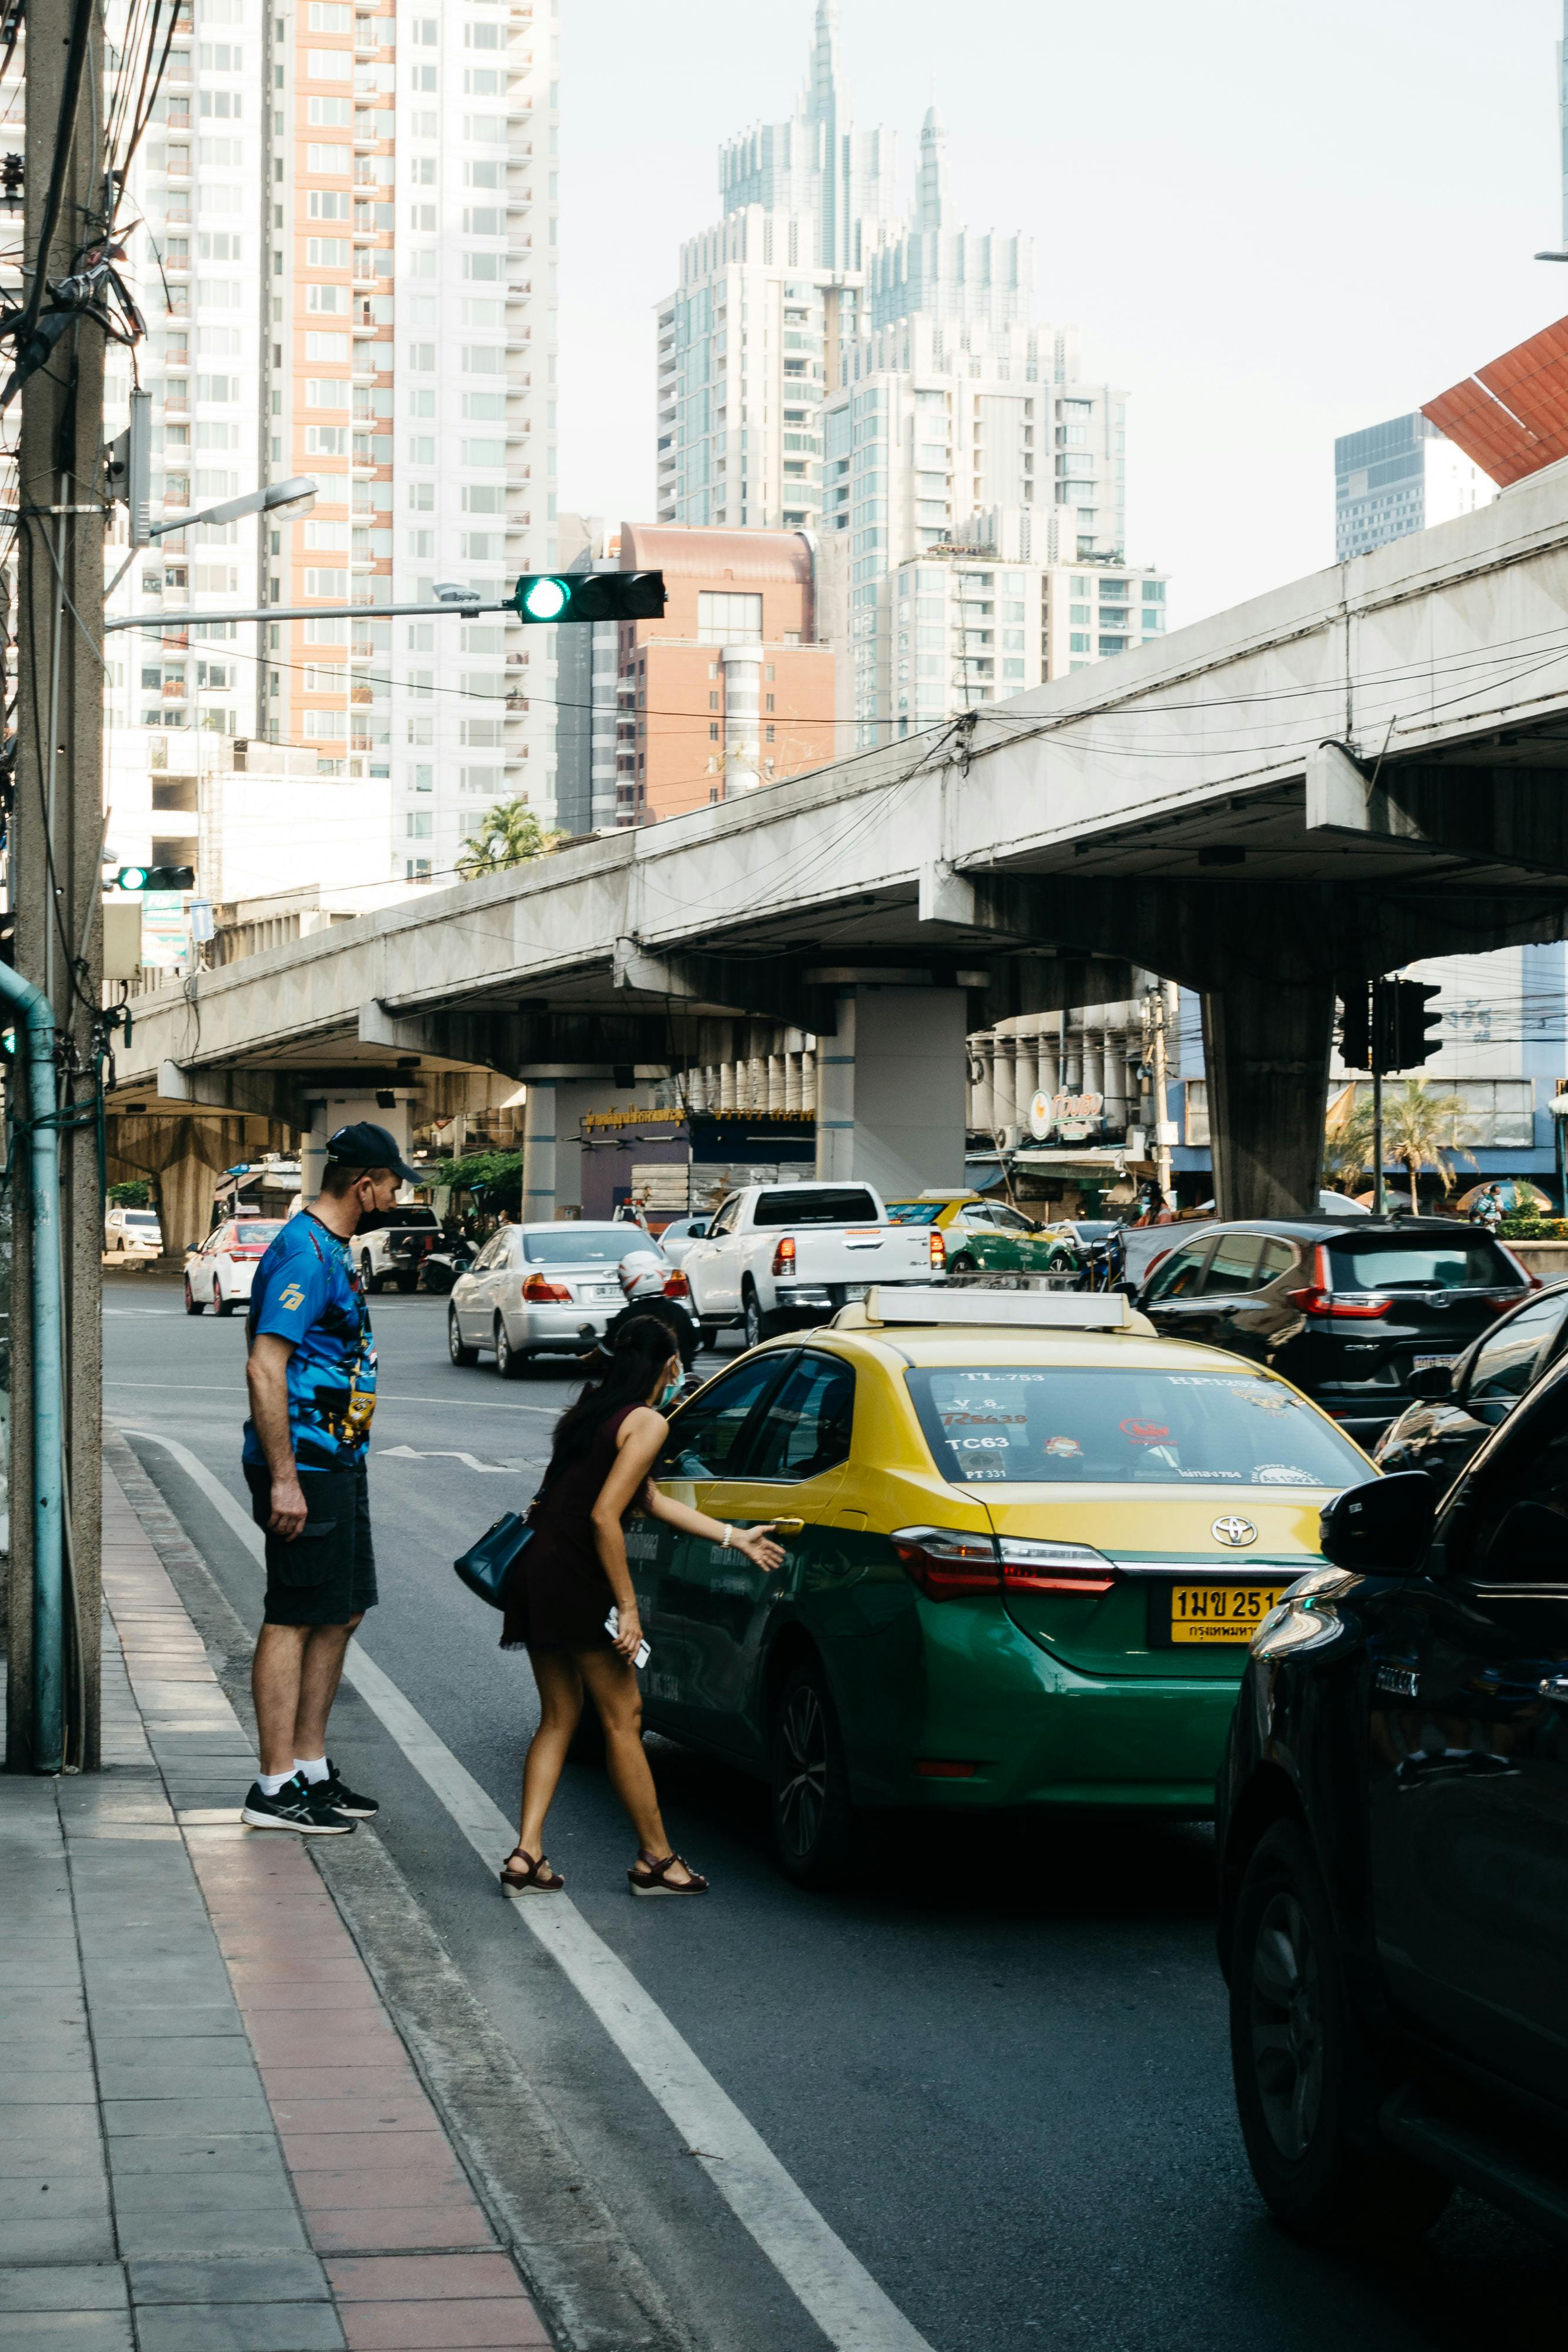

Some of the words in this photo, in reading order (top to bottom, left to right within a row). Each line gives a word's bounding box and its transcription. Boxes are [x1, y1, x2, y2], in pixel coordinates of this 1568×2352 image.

[959, 1372, 1045, 1382] TL.753
[953, 1399, 970, 1407] V
[945, 1437, 1010, 1450] TC63
[965, 1470, 983, 1479] PT
[987, 1470, 1006, 1478] 331
[1177, 1590, 1226, 1617] 1มข
[1232, 1591, 1277, 1617] 251
[1189, 1625, 1257, 1640] กรุงเทพมหา
